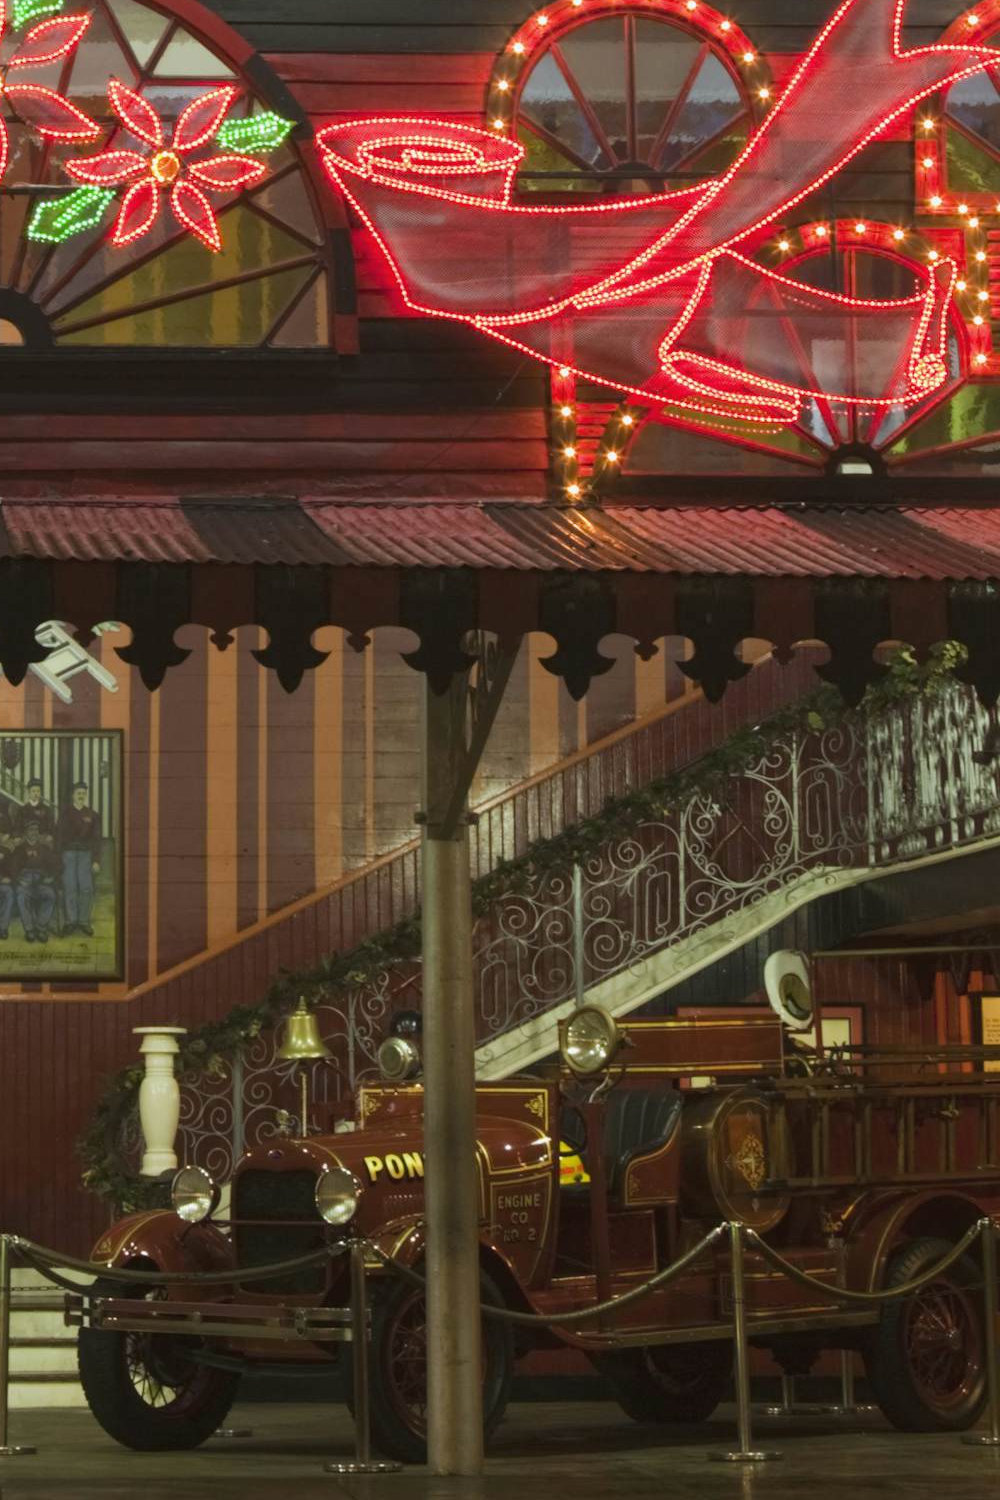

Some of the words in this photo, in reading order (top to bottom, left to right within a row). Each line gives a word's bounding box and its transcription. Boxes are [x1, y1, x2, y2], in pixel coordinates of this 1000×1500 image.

[363, 1151, 426, 1182] PON
[497, 1193, 541, 1210] ENGINE
[511, 1211, 529, 1224] CO
[527, 1228, 537, 1241] 2
